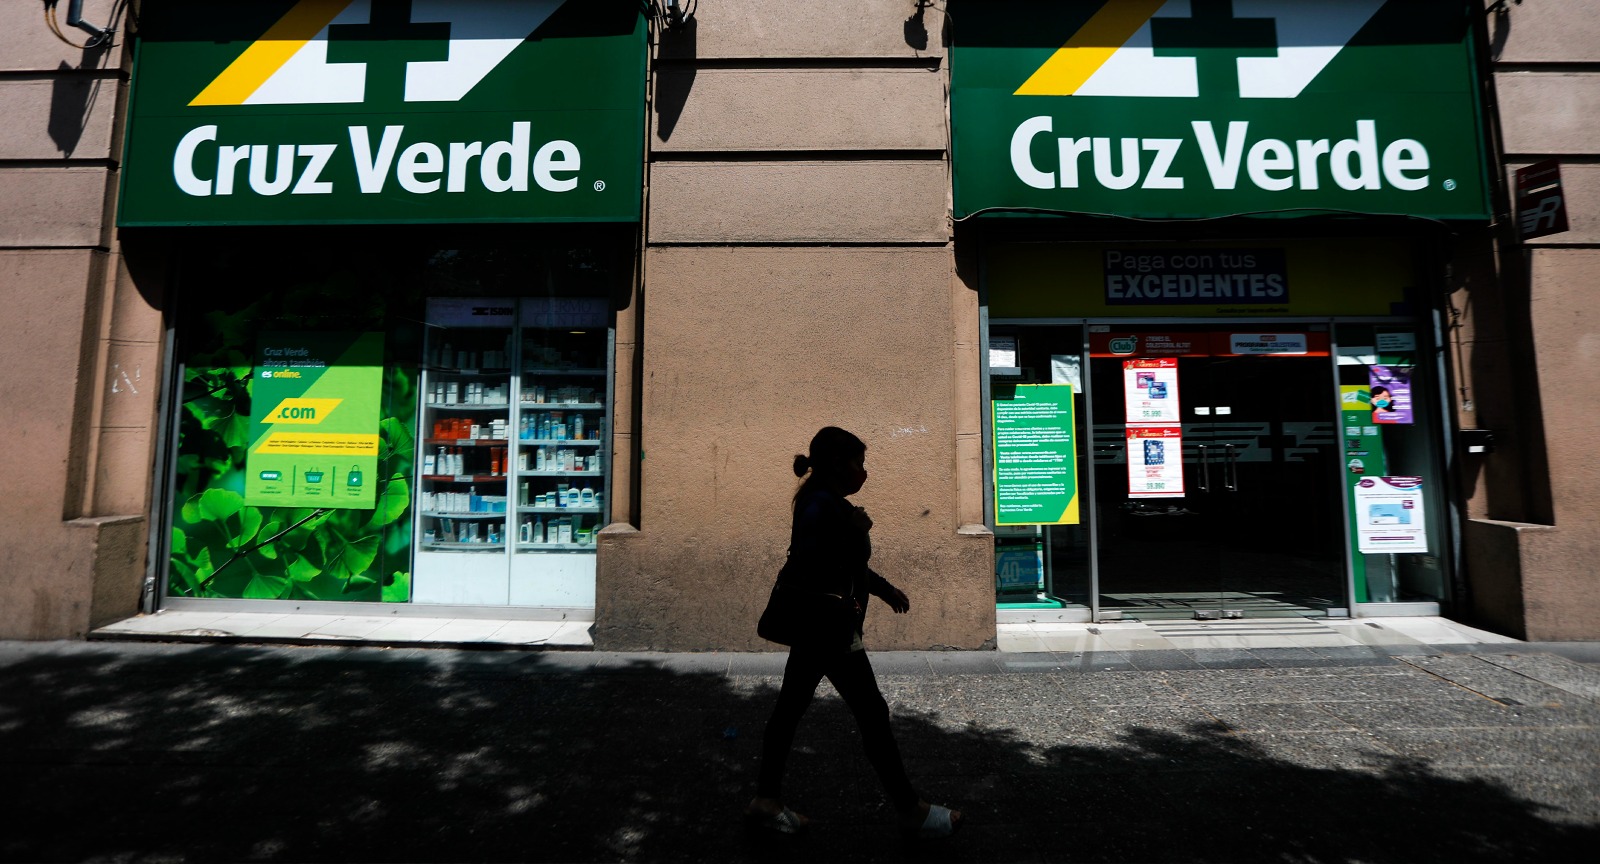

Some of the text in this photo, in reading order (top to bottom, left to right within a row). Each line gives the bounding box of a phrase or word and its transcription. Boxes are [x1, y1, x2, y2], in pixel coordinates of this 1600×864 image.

[173, 121, 581, 197] Cruz Verde
[1010, 115, 1430, 192] Cruz Verde
[1107, 250, 1258, 273] Paga con tus
[1106, 273, 1285, 299] EXCEDENTES
[263, 347, 310, 357] Cruz Verde
[1112, 342, 1131, 351] Club
[263, 358, 326, 368] ahora también
[273, 368, 302, 379] online.
[277, 406, 316, 419] .com
